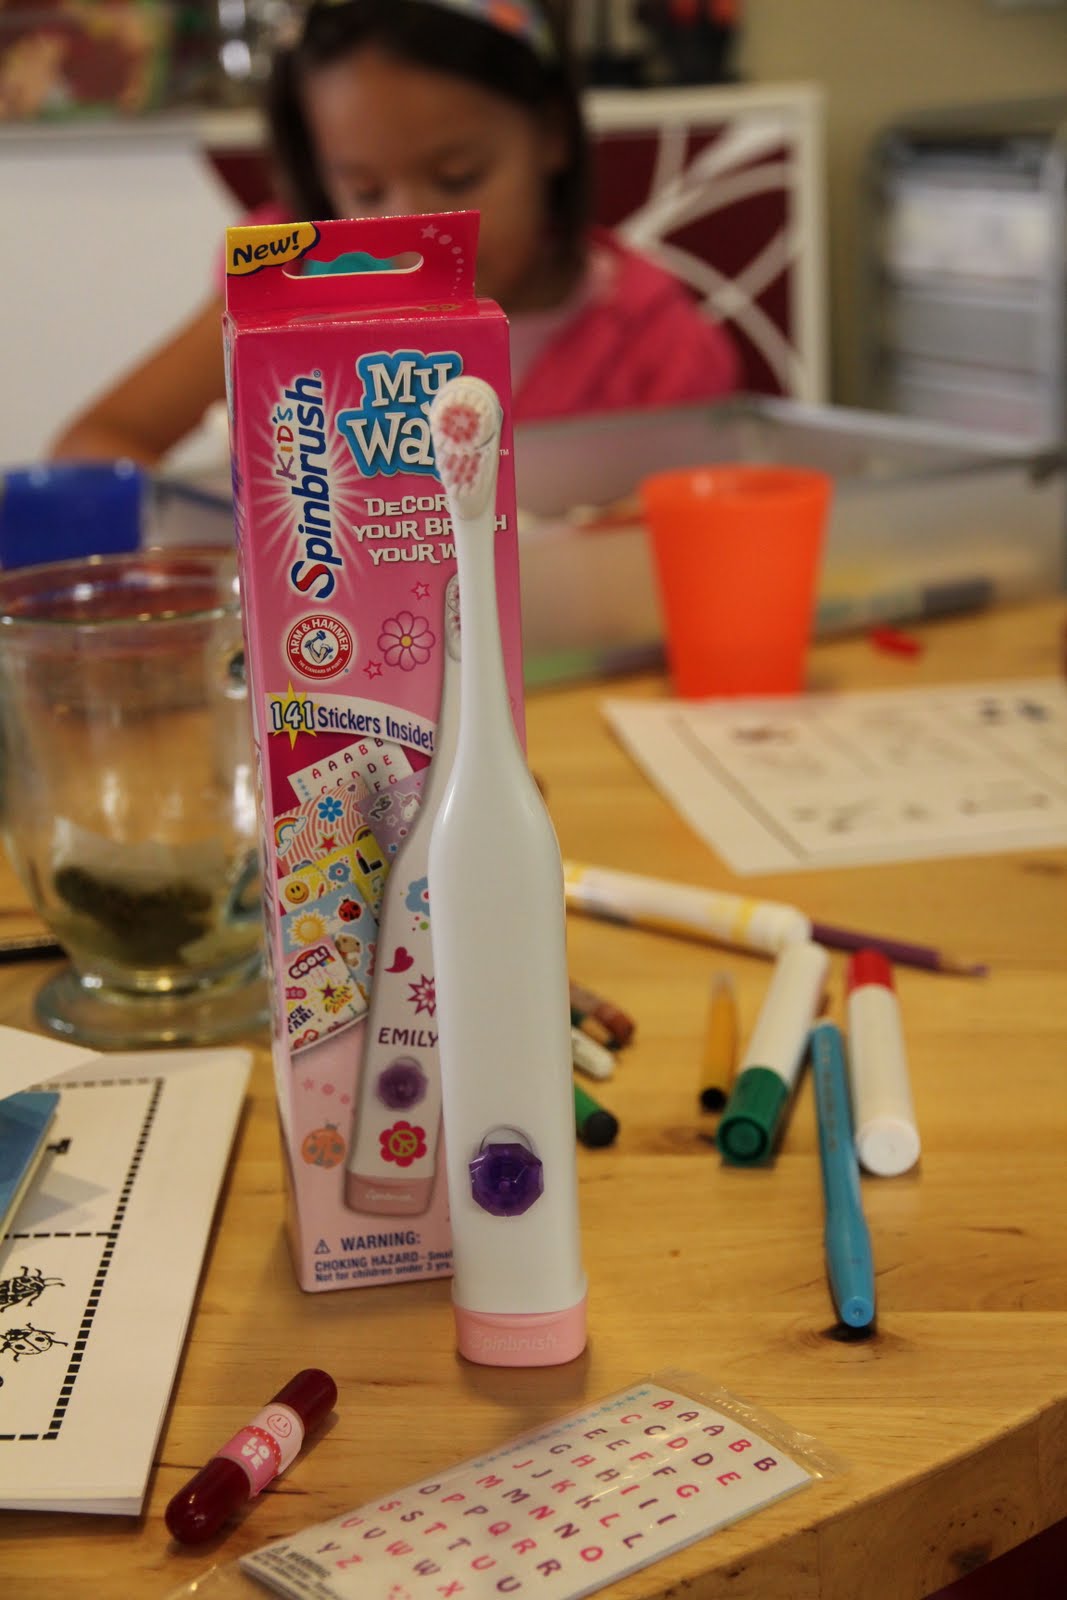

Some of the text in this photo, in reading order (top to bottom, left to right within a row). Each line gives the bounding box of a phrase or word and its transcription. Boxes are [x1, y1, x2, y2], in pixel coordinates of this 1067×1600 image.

[233, 230, 300, 267] New!
[368, 361, 453, 416] My
[346, 411, 435, 467] Wa
[284, 376, 343, 599] Spinbrush
[352, 514, 508, 543] YOUR BRH
[368, 543, 441, 566] YOUR
[290, 618, 350, 655] ARM & HAMMER
[271, 700, 435, 752] 141 Stickers Inside!
[328, 760, 339, 772] A
[344, 752, 354, 764] A
[358, 744, 369, 756] B
[382, 754, 393, 766] E
[378, 1026, 440, 1048] EMILY
[314, 1256, 368, 1272] CHOKING
[371, 1251, 419, 1267] HAZARD
[341, 1231, 422, 1252] WARNING:
[583, 1428, 700, 1498] E E F F G
[620, 1414, 741, 1486] C C D D E
[652, 1400, 778, 1472] A A A B B
[512, 1459, 645, 1549] J J K K L L
[549, 1443, 677, 1526] G H H I I I
[418, 1484, 562, 1577] O P P Q R R
[476, 1475, 604, 1562] M M N N O
[316, 1541, 342, 1554] Y
[378, 1500, 522, 1593] S S T T U U
[385, 1540, 414, 1556] W
[413, 1559, 441, 1576] W
[436, 1580, 465, 1598] X
